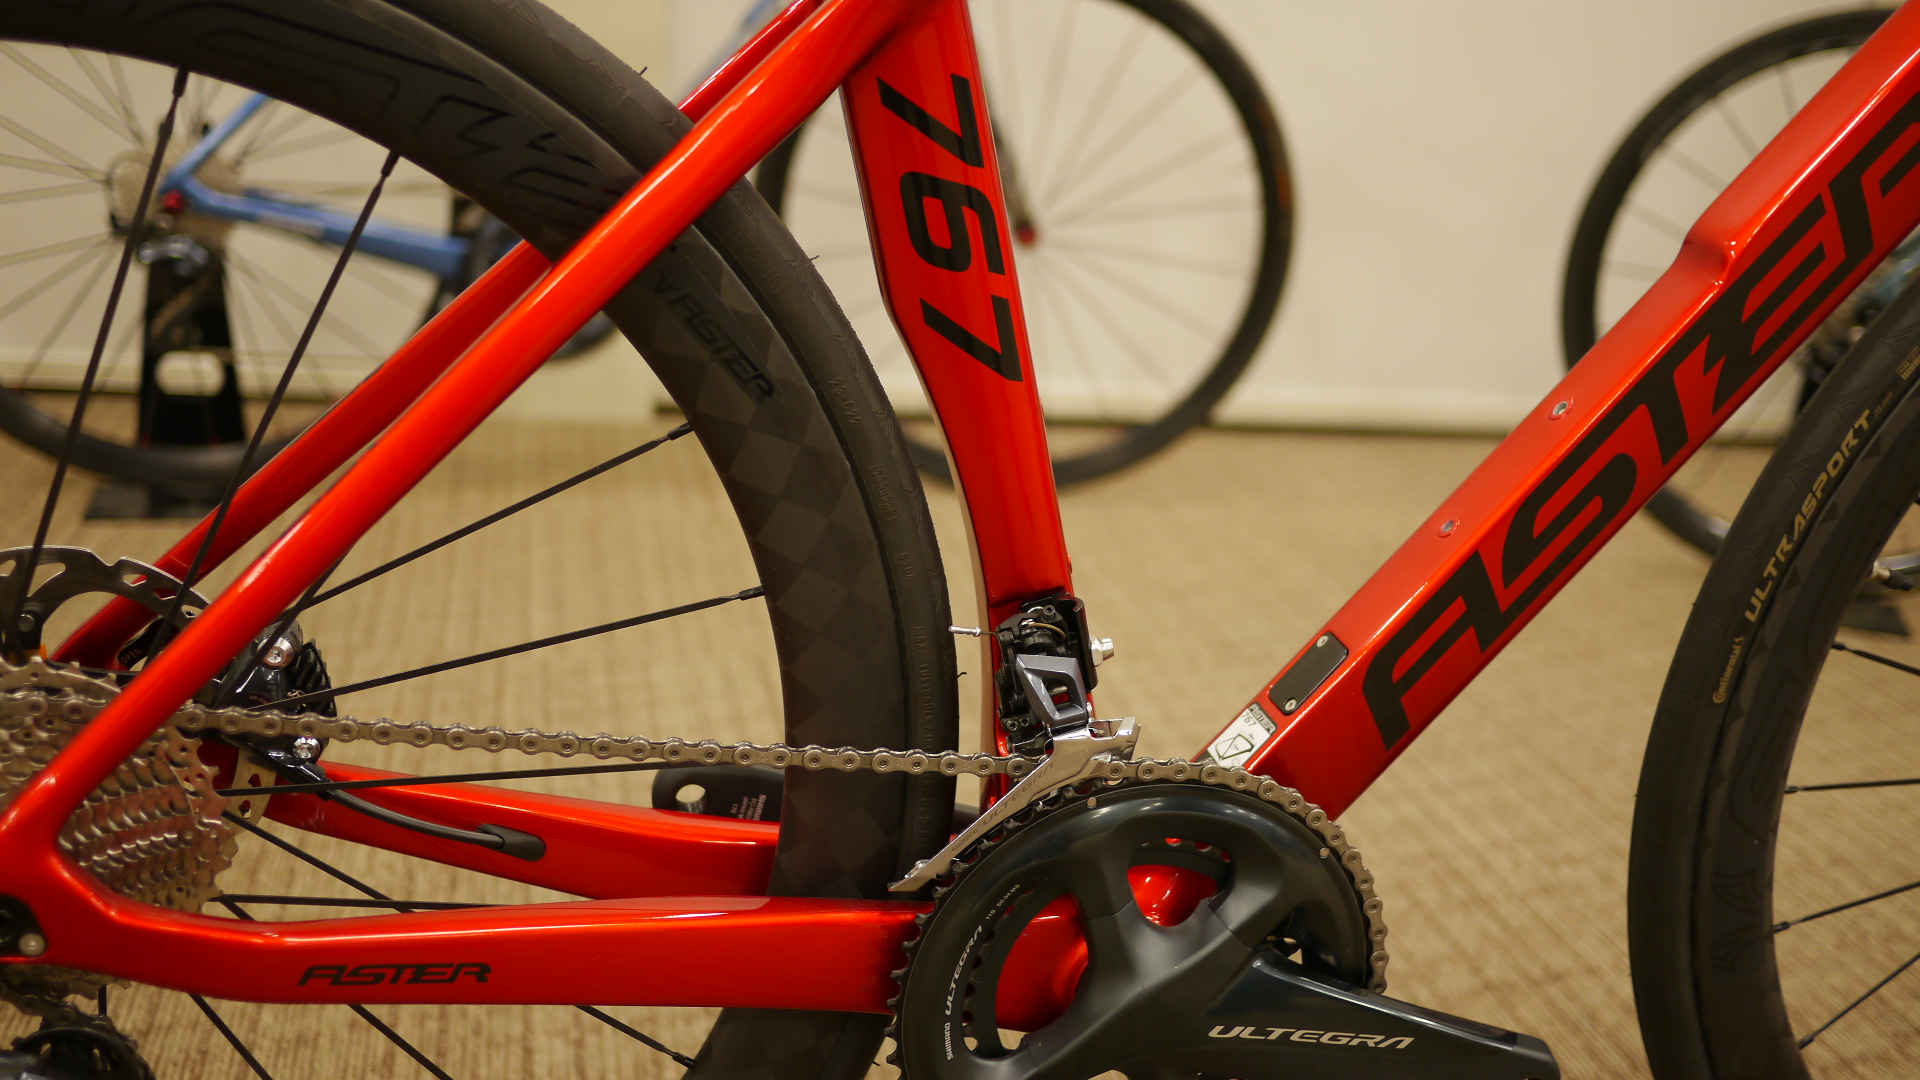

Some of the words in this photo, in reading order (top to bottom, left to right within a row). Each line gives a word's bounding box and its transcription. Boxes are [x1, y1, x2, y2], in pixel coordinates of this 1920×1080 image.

[876, 72, 1024, 383] 767
[669, 294, 775, 404] ASTER
[120, 648, 142, 665] OPEN
[1241, 711, 1257, 727] 767
[1249, 702, 1277, 734] ASTER
[753, 794, 766, 820] SHIMA
[982, 762, 1054, 828] ULTEGRA
[951, 828, 979, 852] SHIMANO
[296, 962, 492, 987] ASTER
[945, 924, 983, 1016] ULTEGRA
[944, 1021, 954, 1061] SHIMANO
[1207, 1025, 1415, 1049] ULTEGRA
